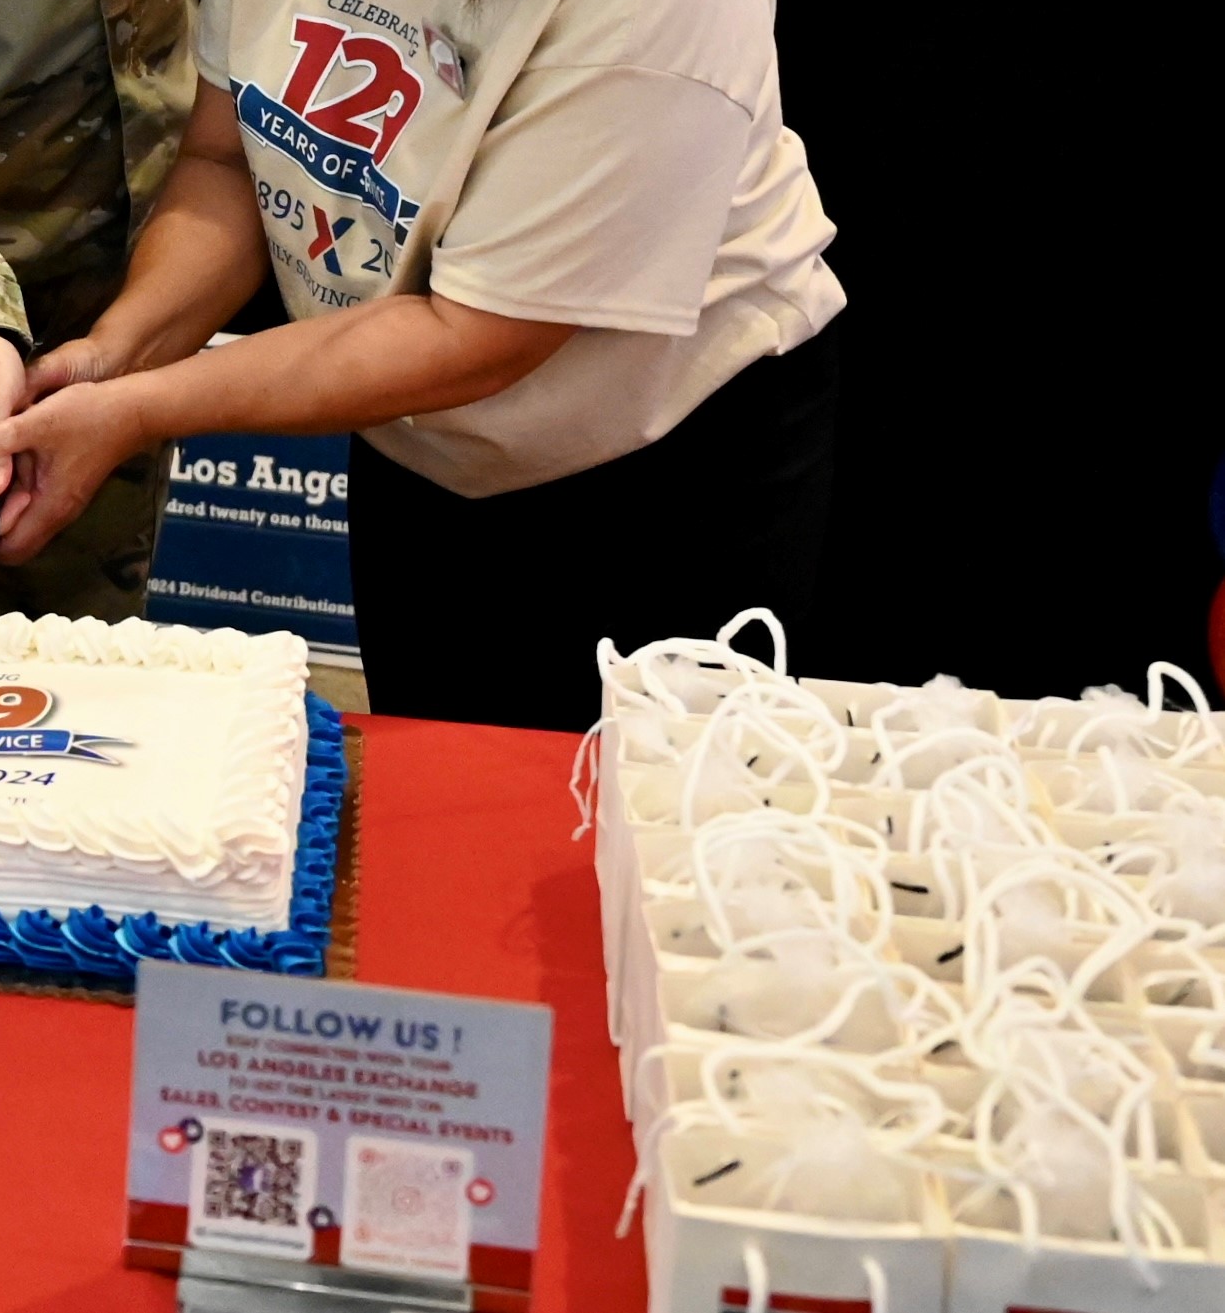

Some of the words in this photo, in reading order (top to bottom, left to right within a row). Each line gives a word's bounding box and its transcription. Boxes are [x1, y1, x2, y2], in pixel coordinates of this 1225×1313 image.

[259, 107, 319, 164] YEARS
[322, 153, 358, 180] OF
[252, 174, 306, 231] 895
[170, 446, 237, 486] Los
[246, 454, 349, 506] Ange
[165, 498, 206, 517] dred
[209, 503, 267, 526] twenty
[270, 512, 302, 528] one
[179, 581, 248, 603] Dividend
[250, 590, 355, 616] Contributions
[220, 998, 382, 1042] FOLLOW
[394, 1019, 440, 1051] US
[197, 1049, 240, 1071] LOS
